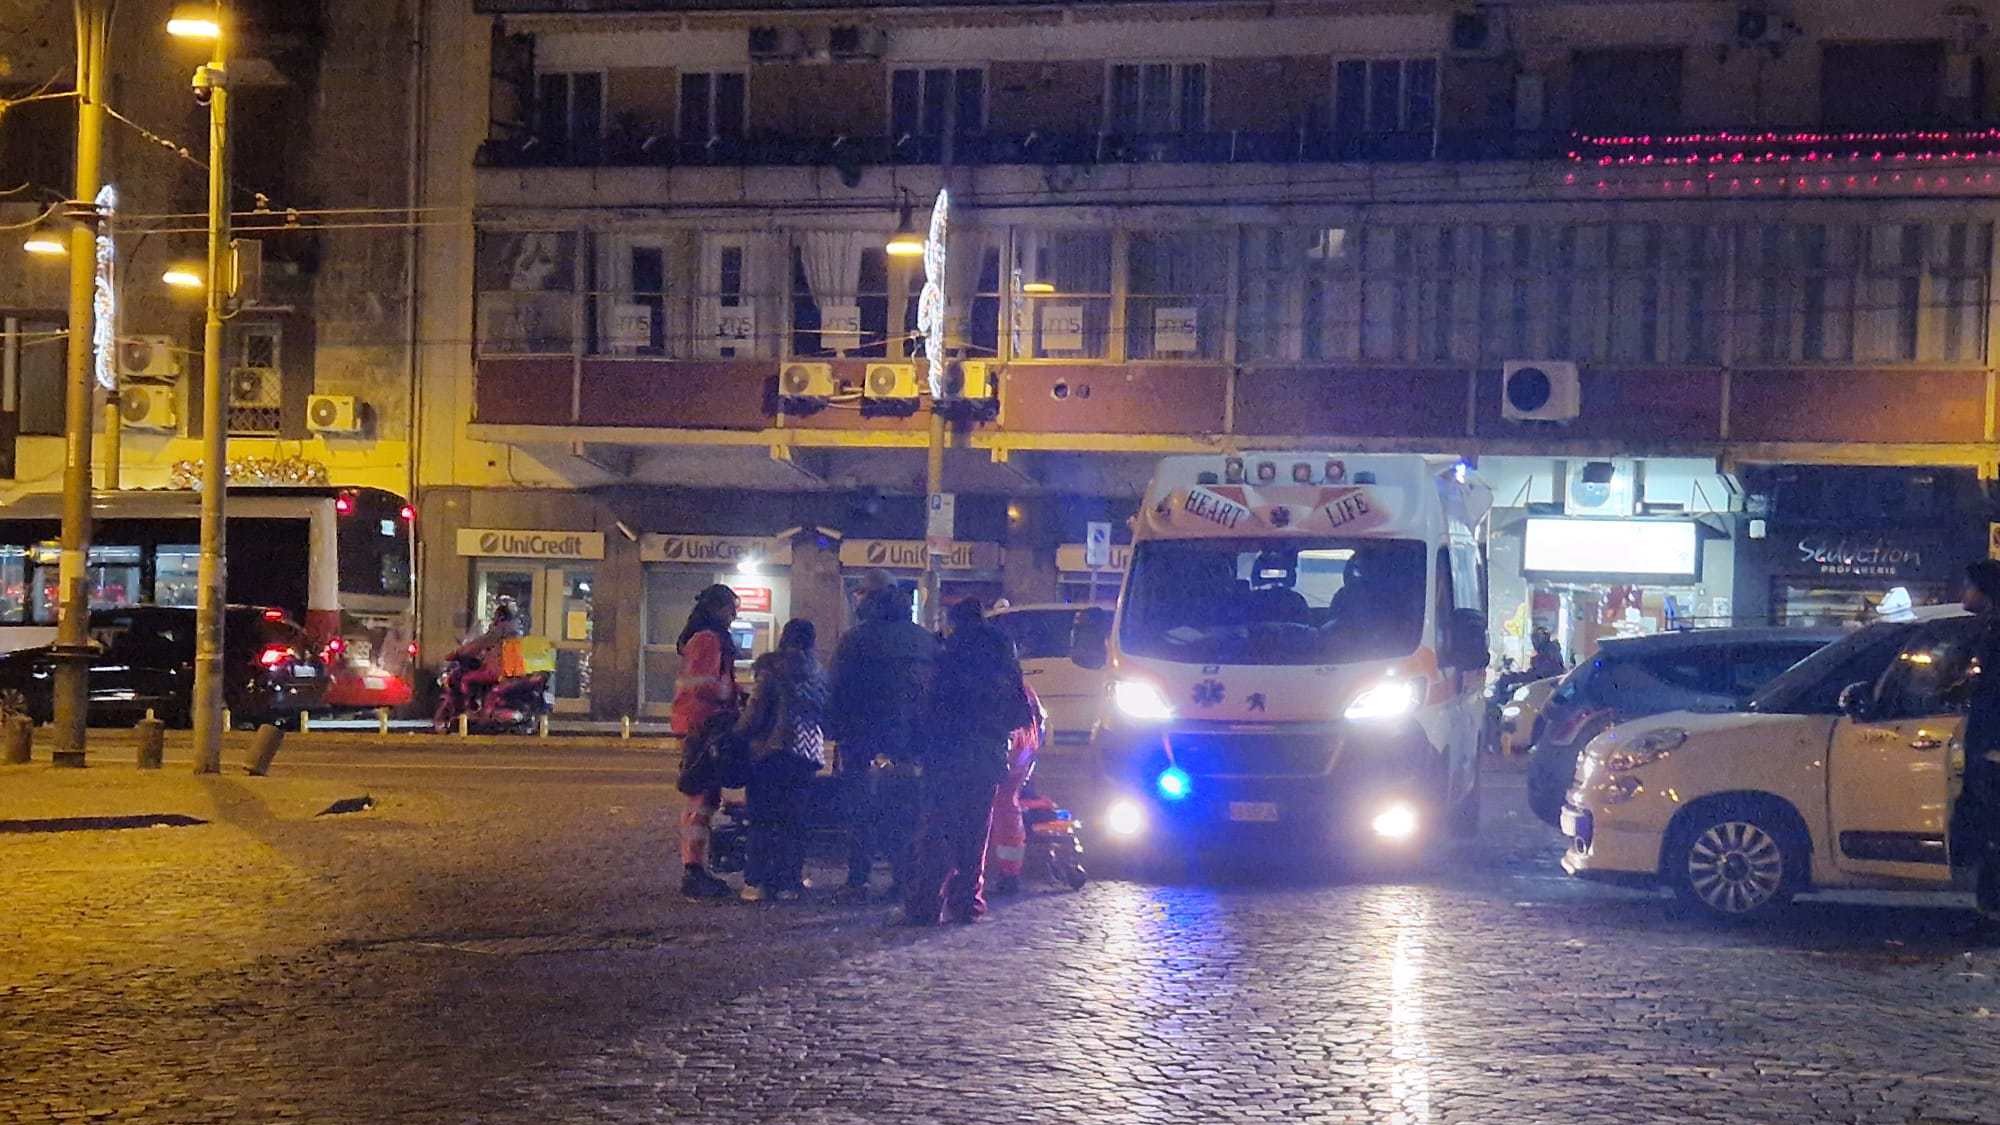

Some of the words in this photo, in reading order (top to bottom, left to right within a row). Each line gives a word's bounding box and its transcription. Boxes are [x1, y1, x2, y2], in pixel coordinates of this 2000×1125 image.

[1184, 489, 1245, 529] HEART
[1325, 491, 1369, 528] LIFE
[502, 533, 583, 555] UniCredit
